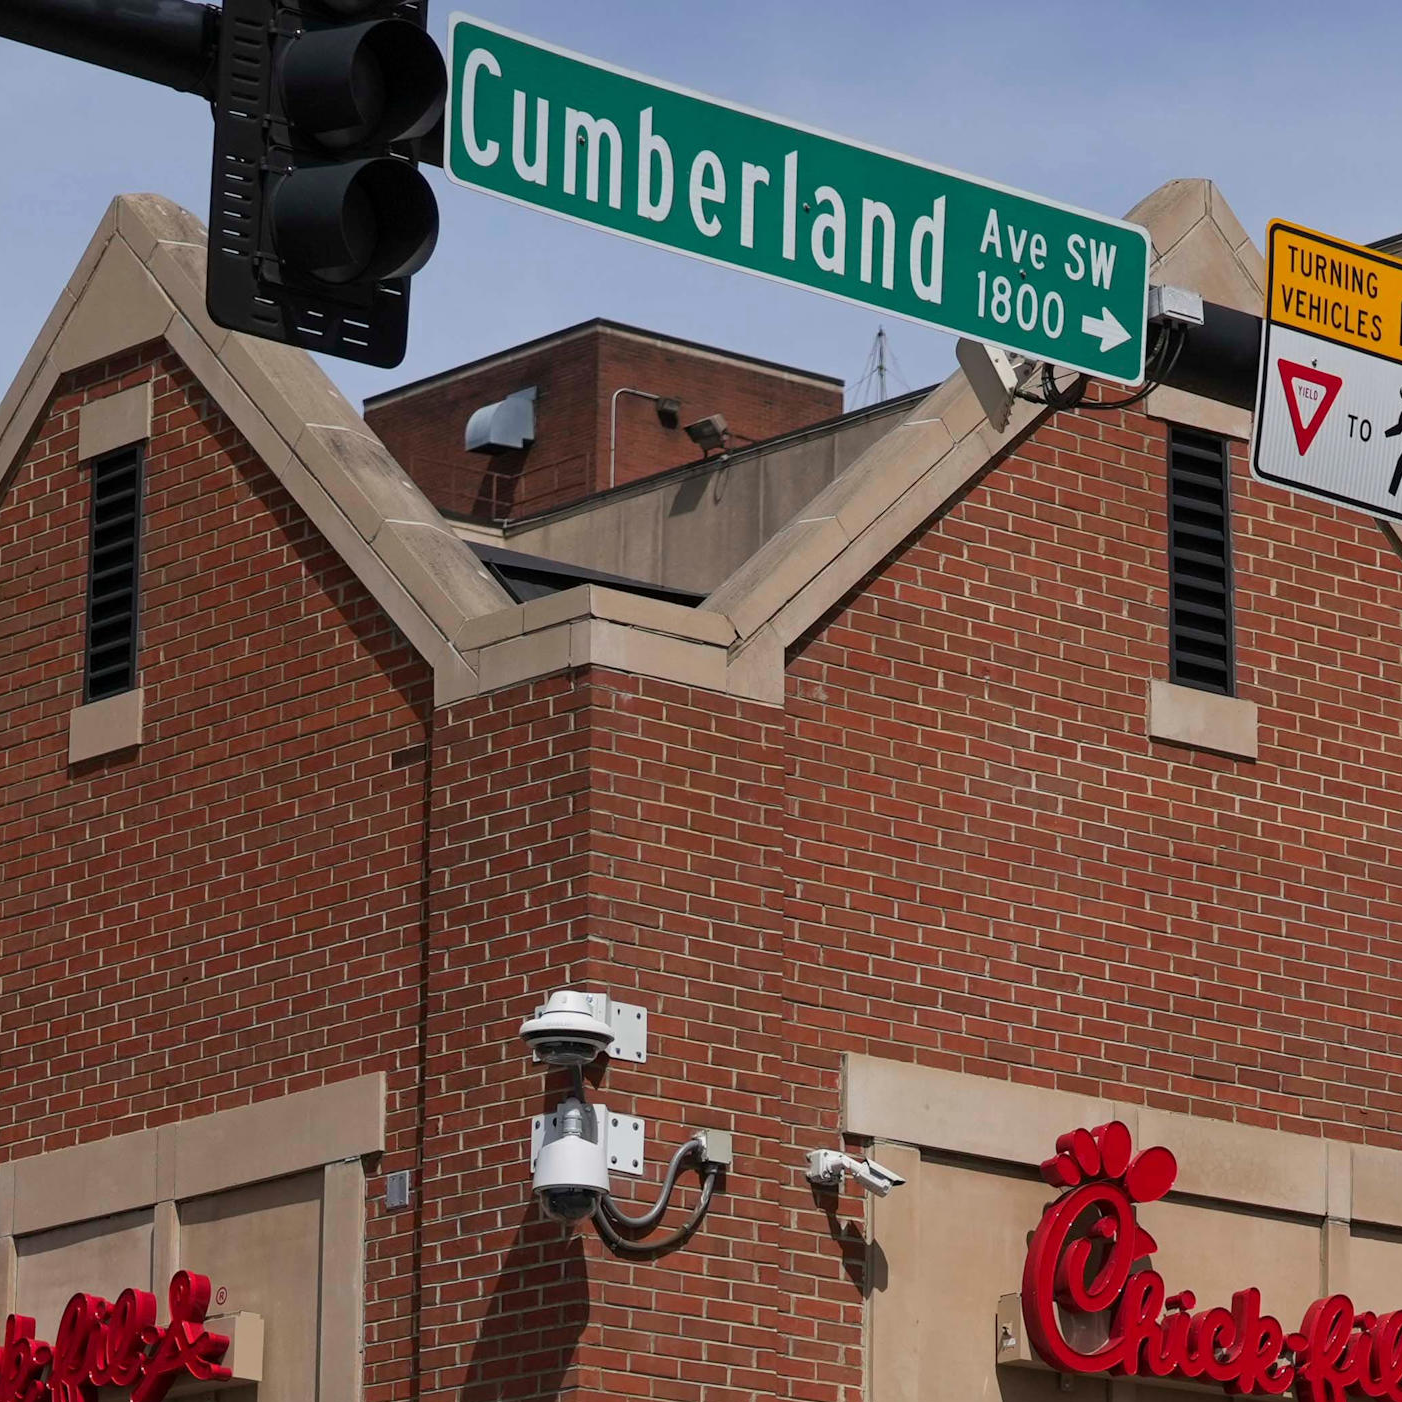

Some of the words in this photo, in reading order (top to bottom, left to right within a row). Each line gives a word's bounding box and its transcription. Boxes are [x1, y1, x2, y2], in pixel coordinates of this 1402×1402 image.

[460, 47, 946, 304] Cumberland
[976, 207, 1049, 270] Ave
[1063, 232, 1117, 290] SW
[1287, 244, 1378, 299] TURNING
[976, 270, 1065, 340] 1800
[1281, 284, 1382, 342] VEHICLES
[1298, 385, 1319, 401] YIELD
[1348, 414, 1372, 442] TO
